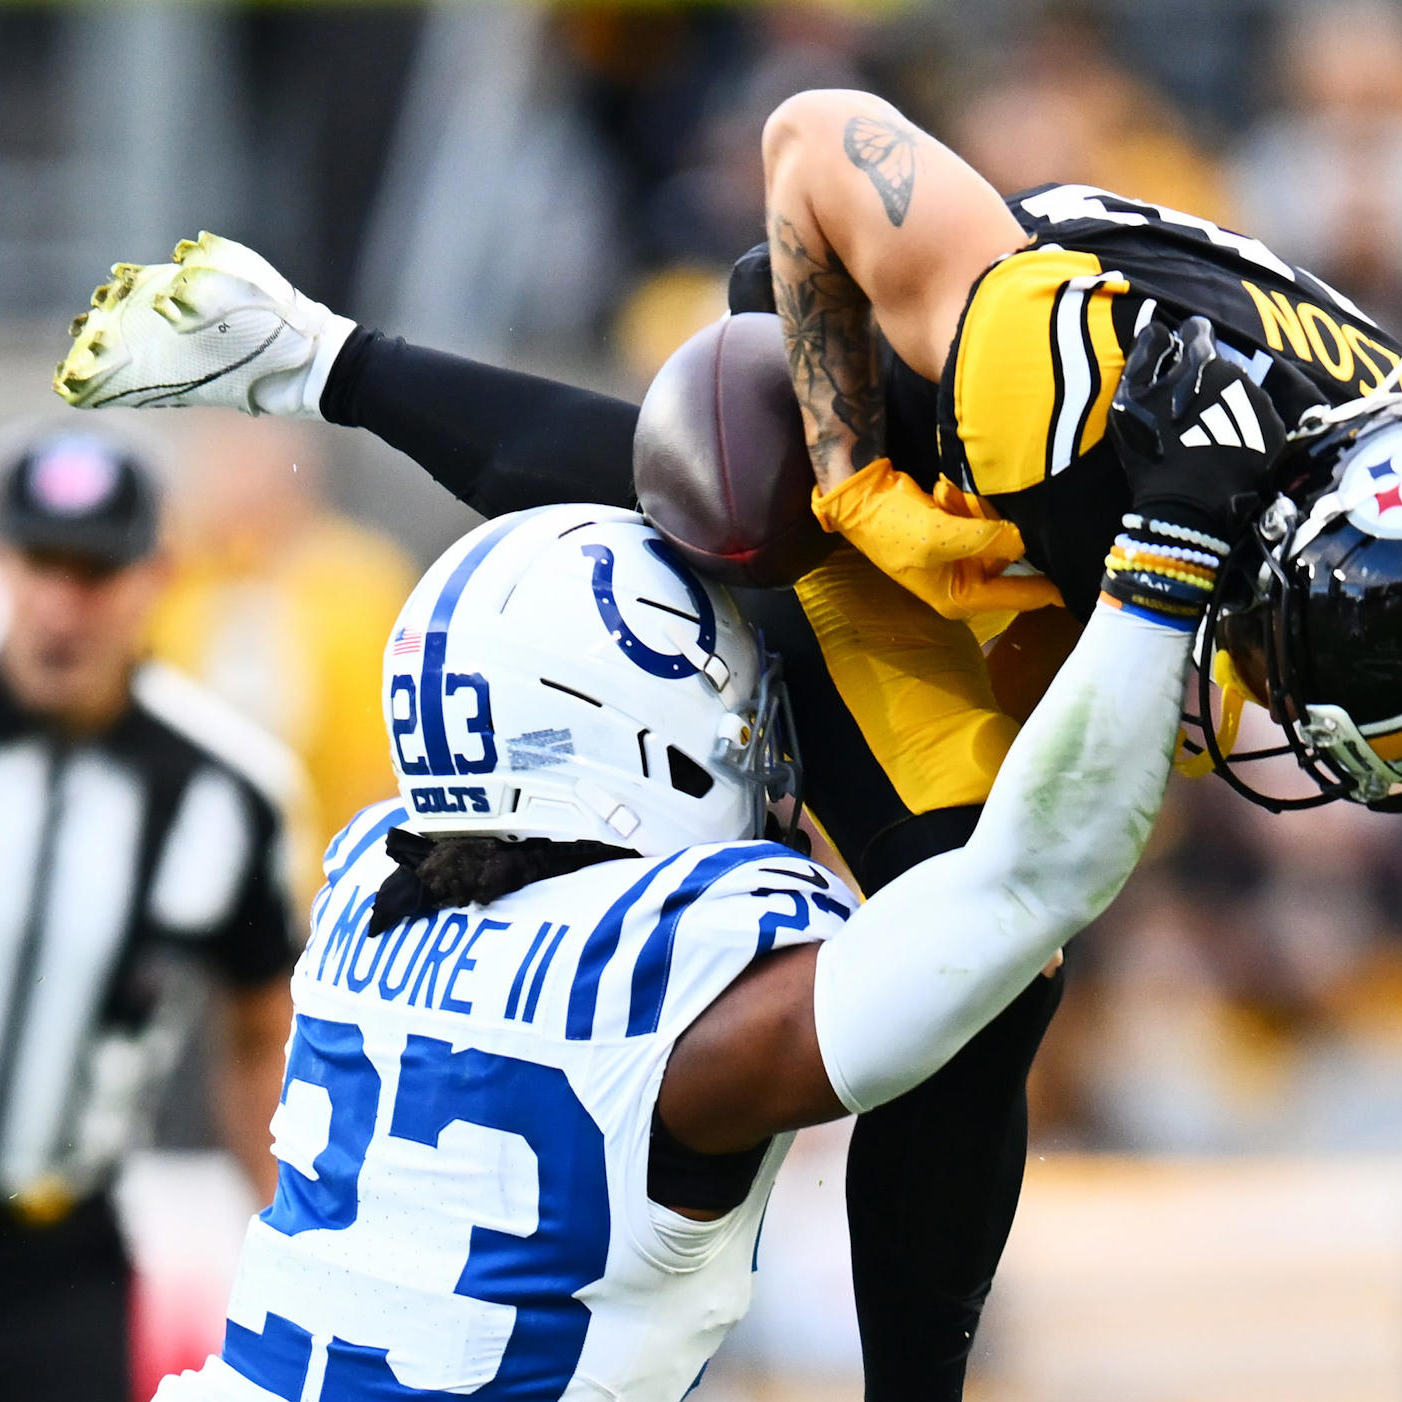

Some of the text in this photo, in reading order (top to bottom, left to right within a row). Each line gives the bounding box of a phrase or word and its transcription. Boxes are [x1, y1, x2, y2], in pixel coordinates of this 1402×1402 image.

[391, 673, 499, 776] 23
[410, 786, 491, 814] COLTS
[316, 885, 513, 1016] MOORE
[503, 921, 571, 1024] II
